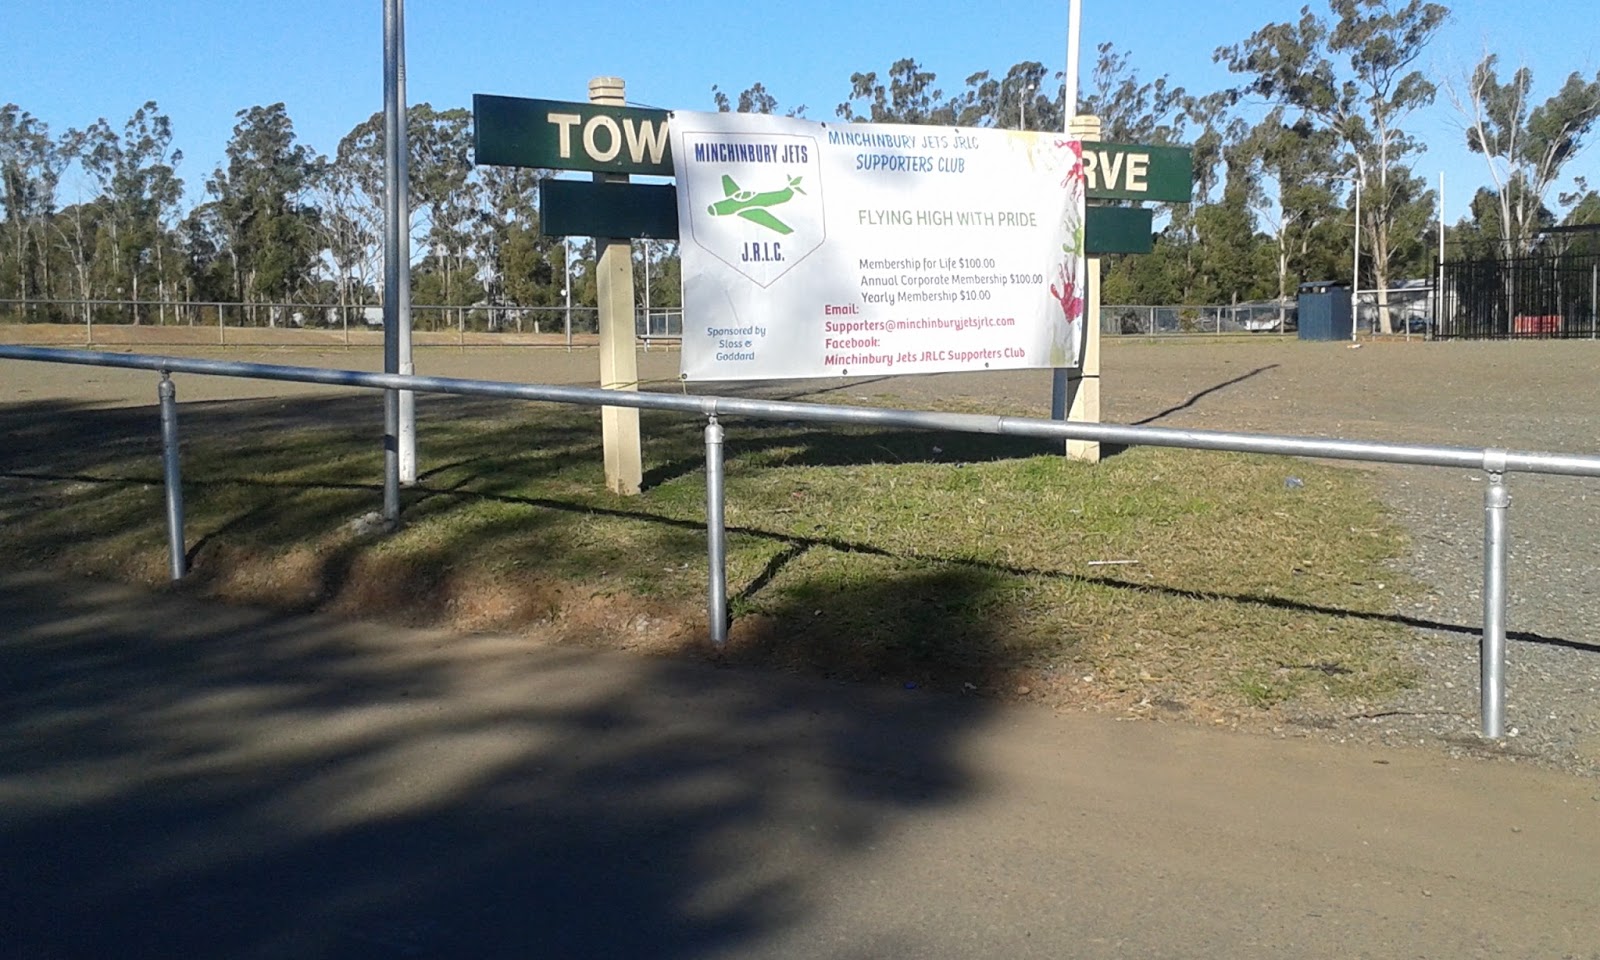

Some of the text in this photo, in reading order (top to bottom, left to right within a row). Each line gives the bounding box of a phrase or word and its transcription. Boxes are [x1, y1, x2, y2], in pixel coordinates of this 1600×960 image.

[547, 112, 669, 164] TOW
[828, 131, 979, 150] MINCHINBURY JETS JRLC
[694, 143, 808, 163] MINCHINBURY JETS
[856, 154, 965, 173] SUPPORTERS CLUB
[1082, 150, 1149, 191] RVE
[858, 209, 1037, 227] FLYING HIGH WITH PRIDE
[859, 258, 995, 271] Membership for Life $100.00
[861, 274, 1043, 287] Annual Corporate Membership $100.00
[861, 290, 991, 306] Yearly Membership $10.00
[825, 304, 859, 315] Email:
[707, 326, 766, 337] Sponsored by
[825, 316, 1015, 333] Supporters@minchinburyjetsjrlc.com
[719, 340, 742, 348] Sloss
[825, 337, 880, 349] Facebook:
[716, 352, 755, 361] Goddard
[825, 347, 1025, 366] Minchinbury Jets JRLC Supporters Club
